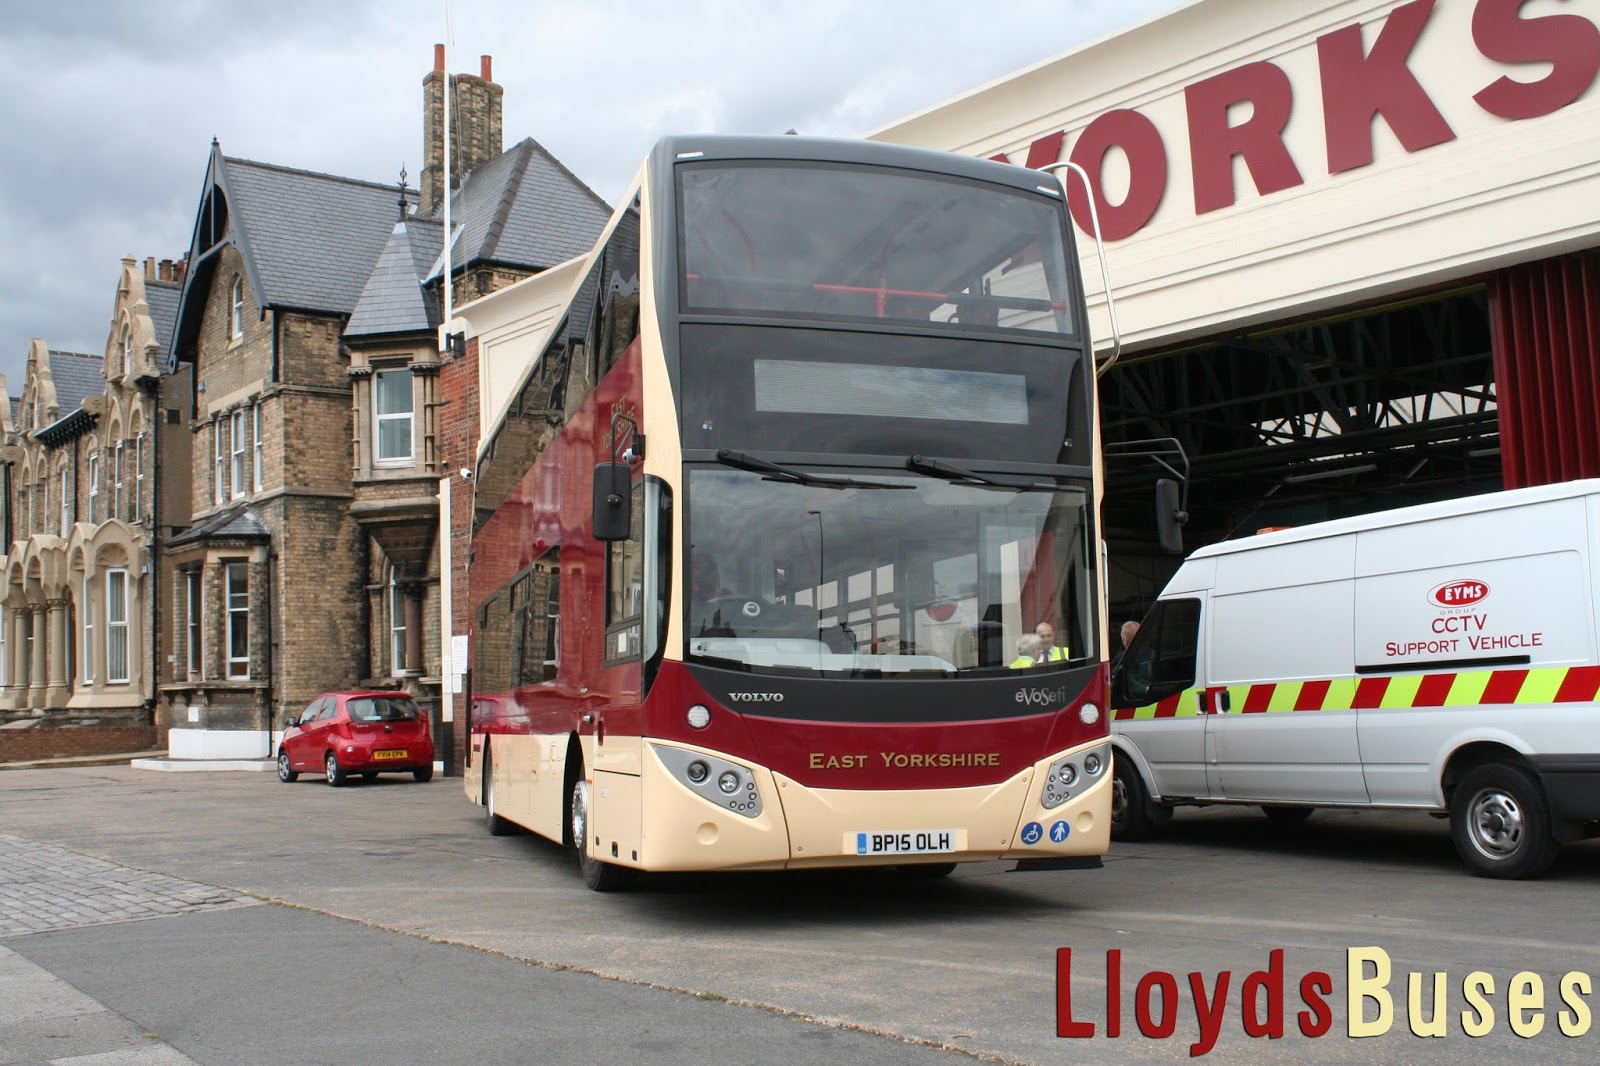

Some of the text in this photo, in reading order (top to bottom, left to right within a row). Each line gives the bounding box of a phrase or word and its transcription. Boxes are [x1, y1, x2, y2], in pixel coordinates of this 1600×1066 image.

[1444, 584, 1482, 601] EYMS
[1440, 607, 1477, 615] GROUP
[1431, 614, 1488, 634] CCTV
[1386, 633, 1543, 657] SUPPORT VEHICLE
[728, 692, 784, 702] VOLVO
[809, 752, 1000, 769] EAST YORKSHIRE
[872, 832, 949, 852] BP15 OLH
